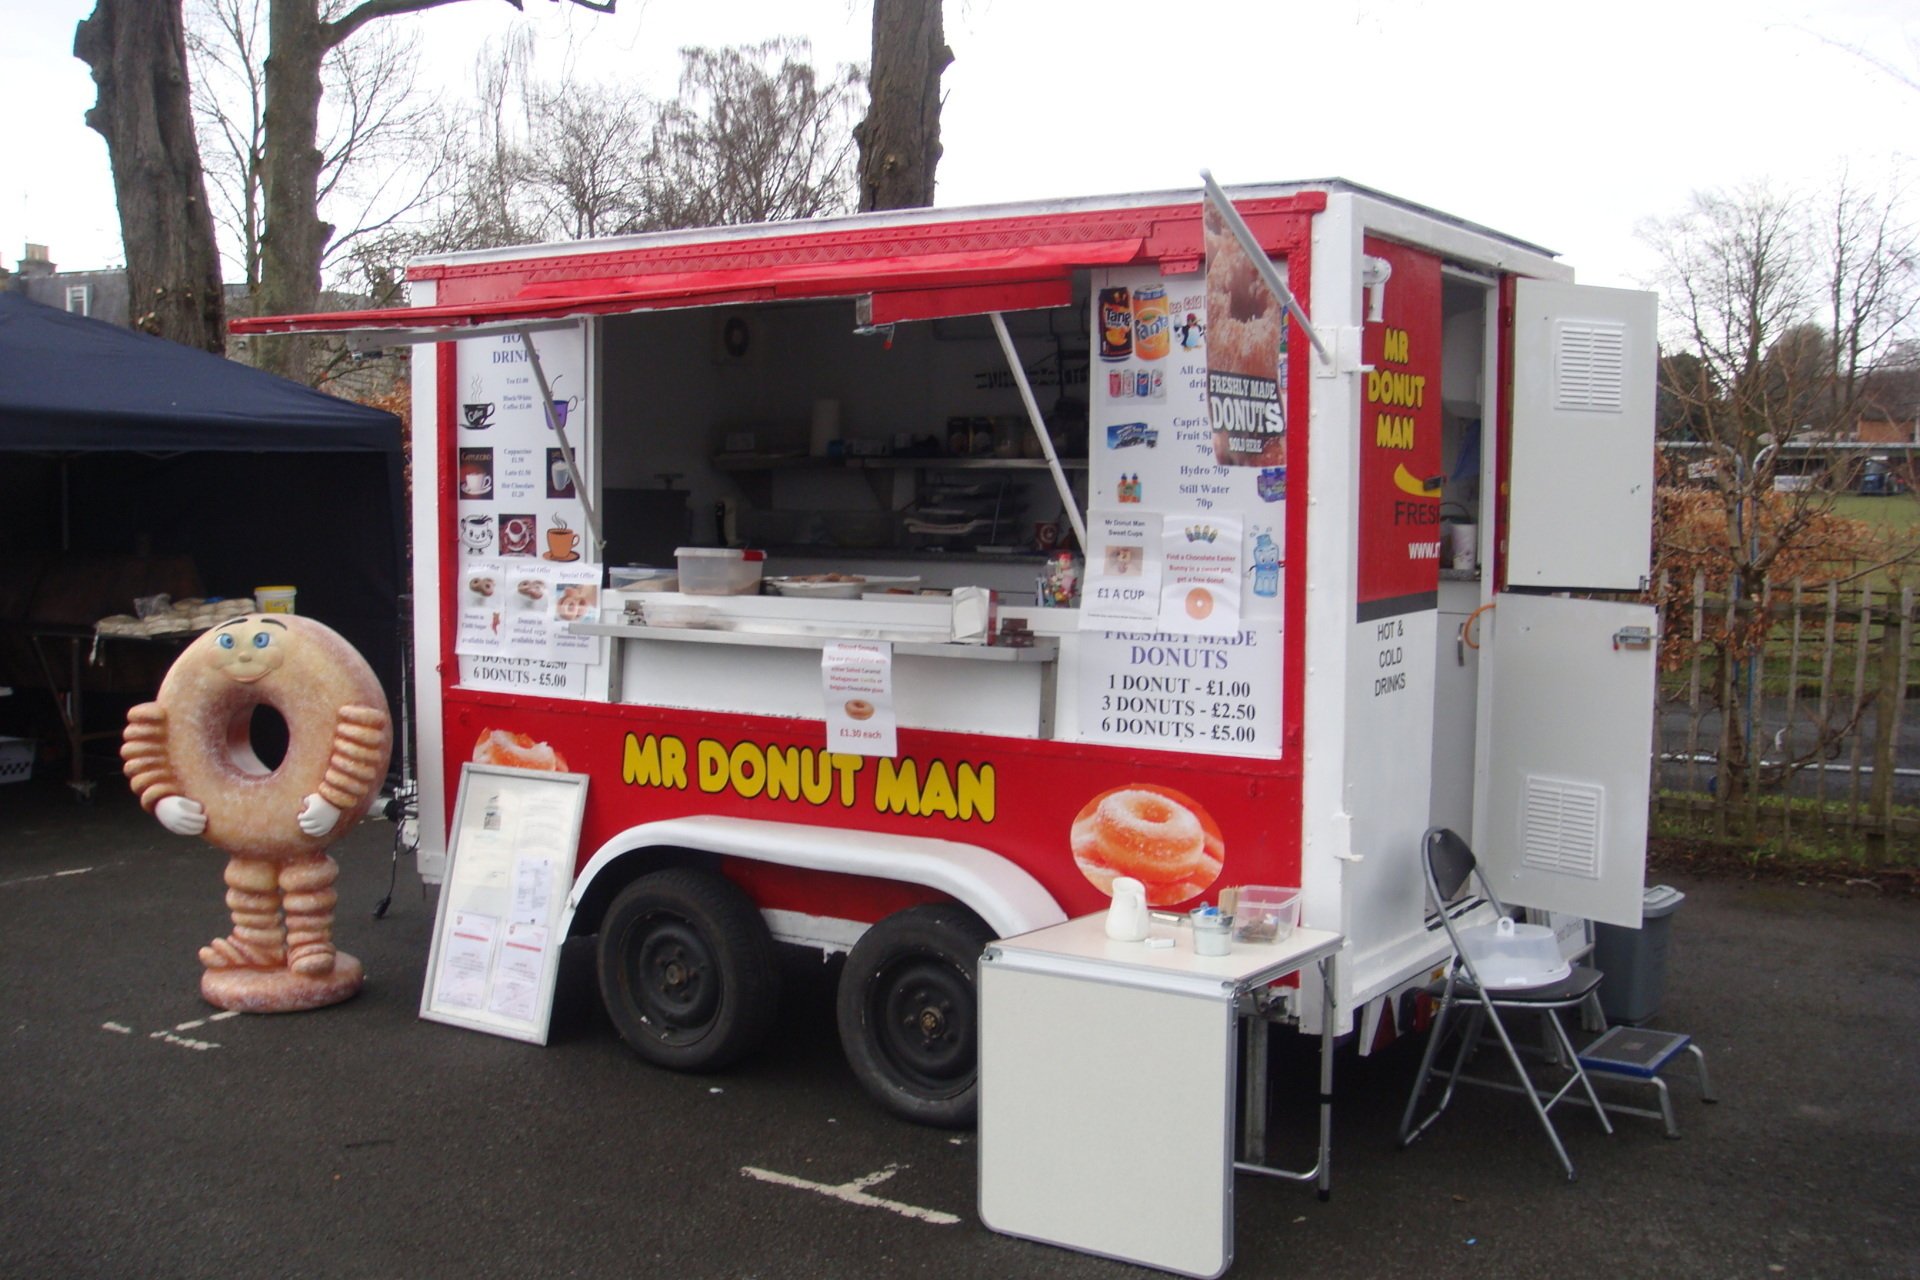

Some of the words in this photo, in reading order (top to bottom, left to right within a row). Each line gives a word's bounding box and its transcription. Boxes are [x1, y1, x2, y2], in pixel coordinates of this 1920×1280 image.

[1106, 308, 1132, 326] Tang
[1384, 327, 1408, 364] MR
[1180, 365, 1194, 375] All
[1210, 374, 1250, 397] FRESHLY
[1250, 379, 1278, 400] MADE
[1368, 369, 1426, 408] DONUT
[1173, 416, 1200, 430] Capri
[1210, 396, 1284, 434] DONUTS
[1176, 430, 1200, 440] Fruit
[1376, 412, 1414, 450] MAN
[1196, 444, 1213, 456] 70p
[1180, 465, 1210, 477] Hydro
[1212, 465, 1230, 477] 70p
[1179, 484, 1198, 494] Still
[1200, 484, 1230, 494] Water
[1196, 498, 1213, 510] 70p
[1098, 588, 1109, 598] £1
[1112, 588, 1120, 599] A
[1123, 589, 1144, 600] CUP
[1377, 621, 1395, 642] HOT
[1397, 620, 1404, 637] &
[1129, 646, 1228, 670] DONUTS
[1379, 646, 1403, 668] COLD
[473, 666, 480, 678] 6
[482, 667, 530, 684] DONUTS
[539, 673, 566, 687] £5.00
[1108, 674, 1115, 690] 1
[1122, 675, 1190, 694] DONUT
[1206, 681, 1250, 698] £1.00
[1375, 672, 1406, 697] DRINKS
[1102, 695, 1111, 711] 3
[1116, 697, 1195, 717] DONUTS
[1211, 703, 1256, 720] £2.50
[863, 731, 882, 739] each
[1102, 717, 1110, 732] 6
[1116, 718, 1195, 739] DONUTS
[1211, 725, 1255, 743] £5.00
[622, 731, 688, 790] MR
[697, 738, 864, 808] DONUT
[873, 756, 996, 824] MAN
